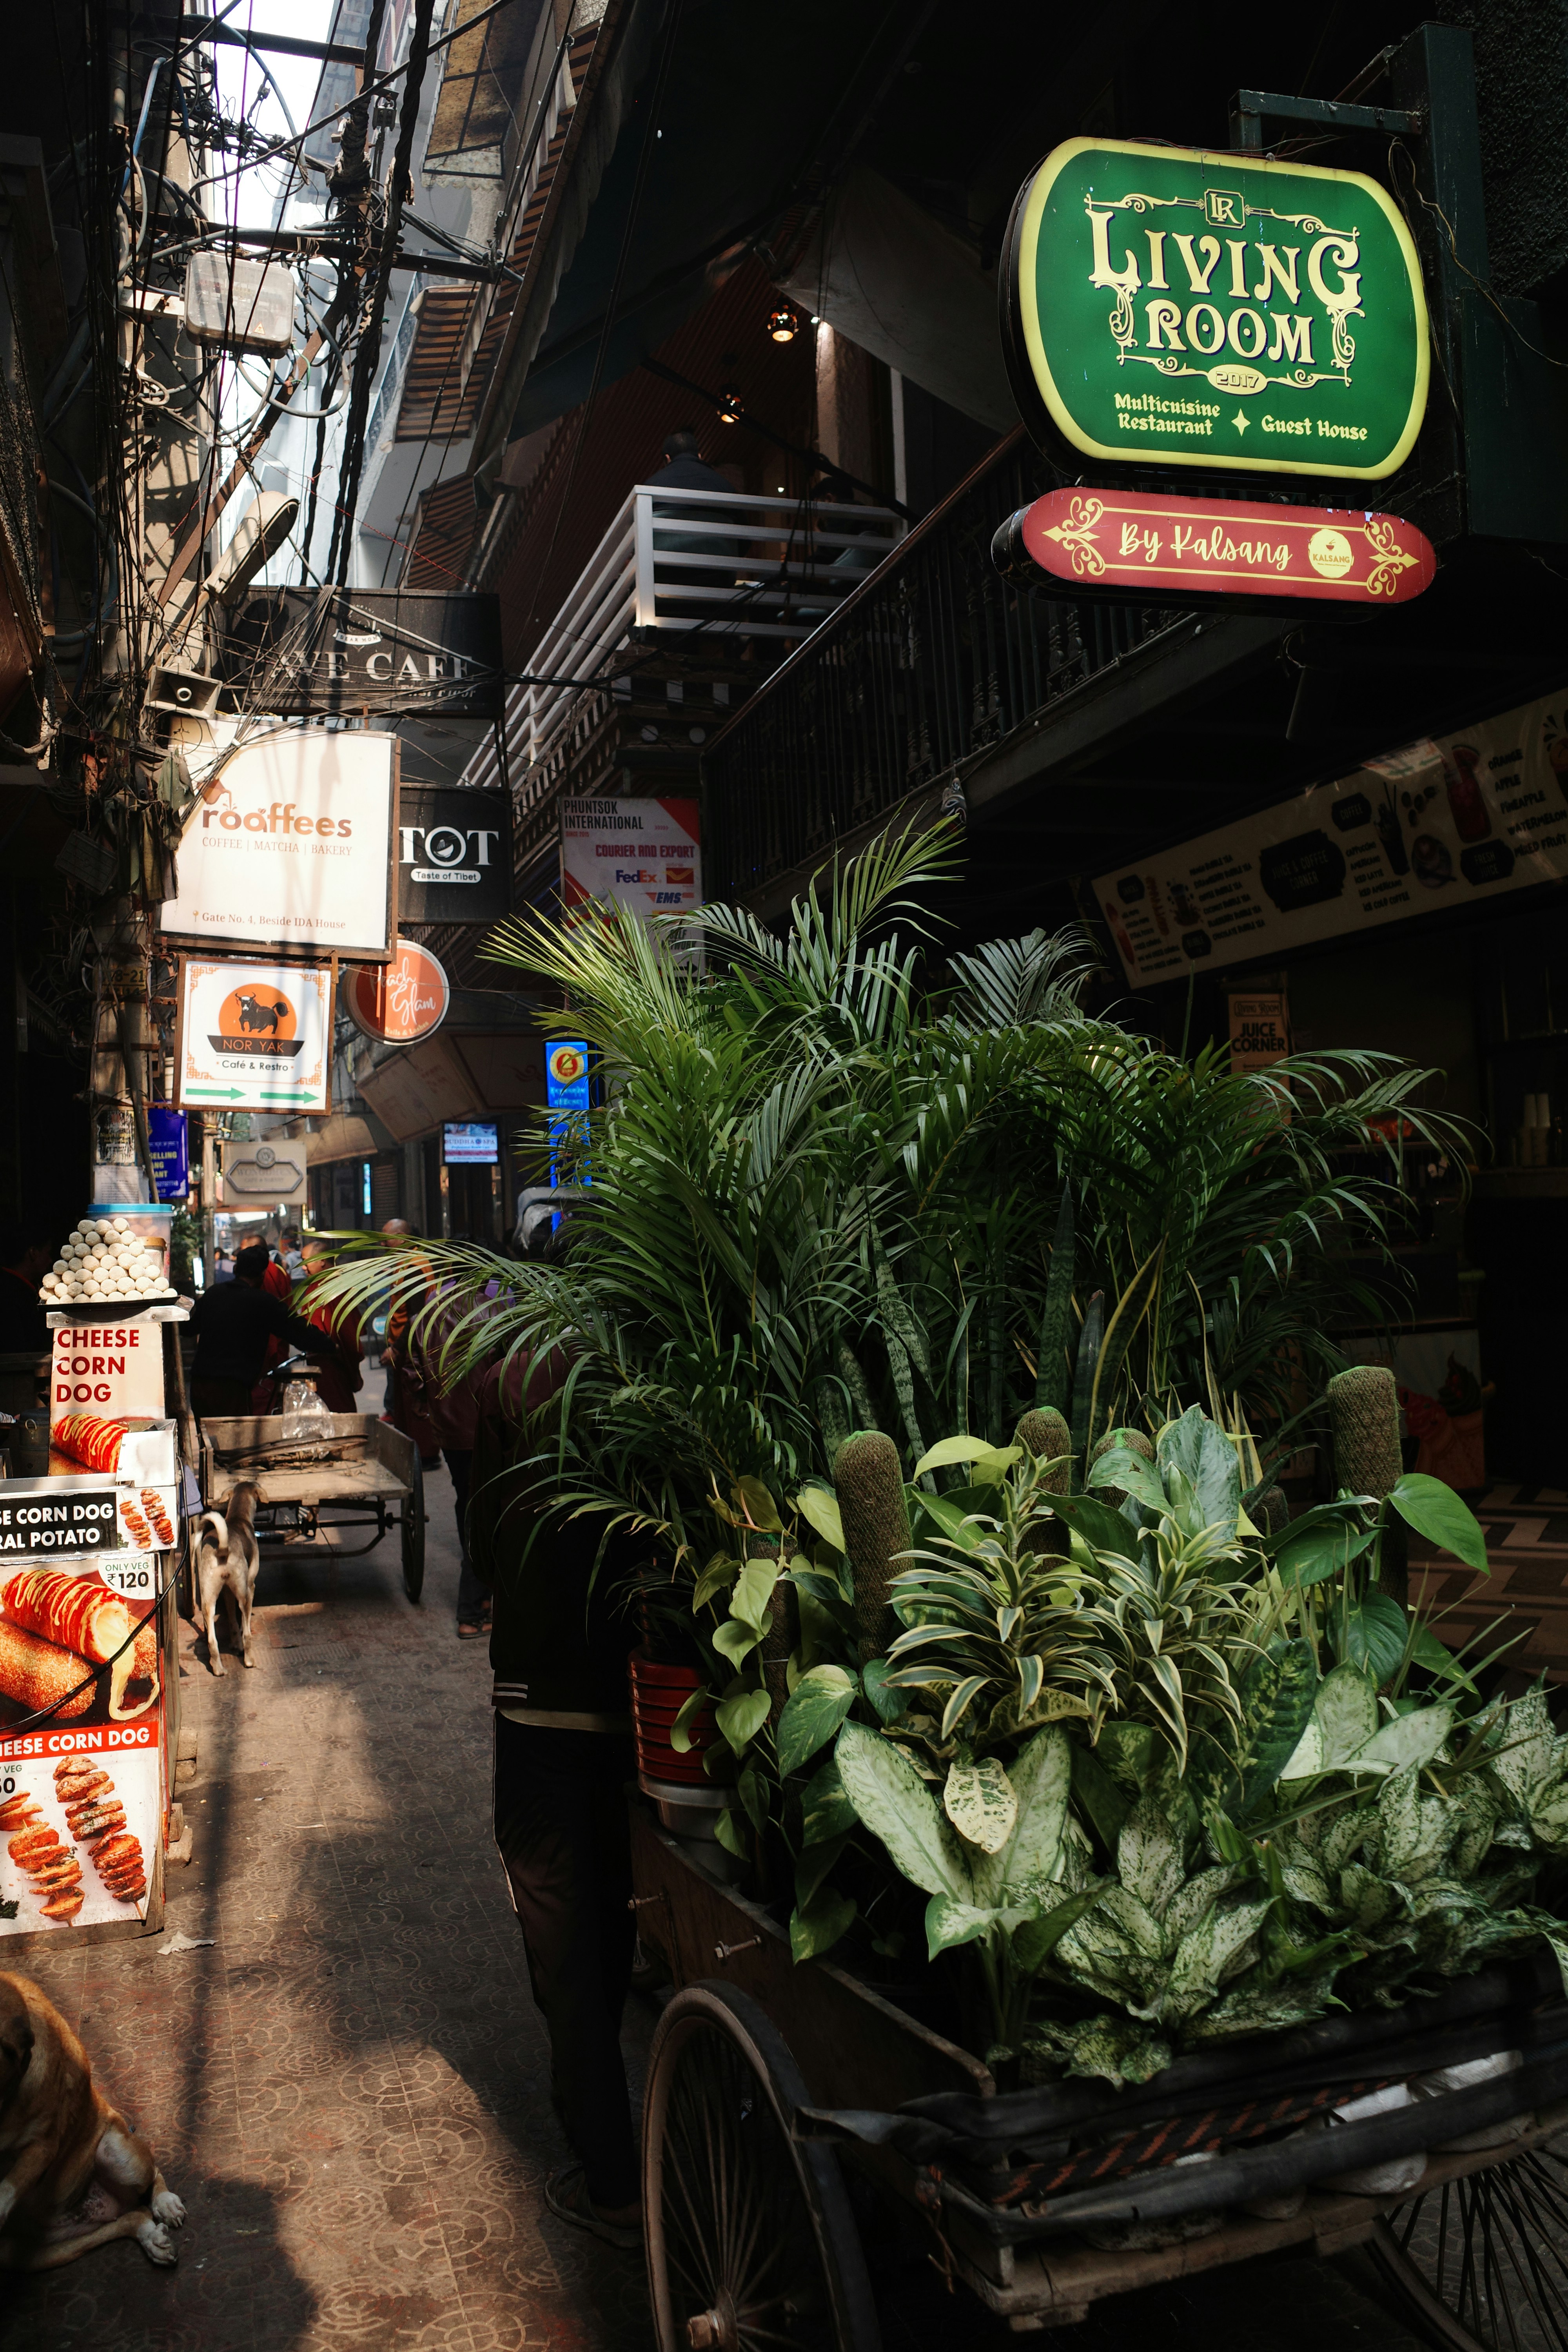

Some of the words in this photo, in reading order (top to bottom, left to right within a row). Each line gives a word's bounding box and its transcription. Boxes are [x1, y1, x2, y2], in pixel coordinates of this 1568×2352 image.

[1085, 208, 1363, 309] LIVING
[1145, 298, 1316, 364] ROOM
[1216, 371, 1259, 388] 2017
[1114, 393, 1220, 417] Multicuisine
[1118, 413, 1213, 436] Restaurant
[1261, 415, 1312, 436] Guest
[1317, 420, 1368, 441] House
[1119, 522, 1163, 563] By
[1170, 526, 1293, 571] Kalsang
[1313, 554, 1350, 563] KALSANG
[1494, 774, 1521, 792] APPLE
[564, 800, 618, 814] PHUNTSOK
[1500, 790, 1546, 814] PINEAPPLE
[1340, 804, 1364, 820] COFFEE
[565, 815, 644, 829] INTERNATIONAL
[202, 837, 242, 849] COFFEE
[254, 840, 299, 853] MATCHA
[311, 844, 352, 856] BAKERY
[398, 826, 499, 867] TOT
[1541, 833, 1567, 850] FRUIT
[596, 845, 636, 857] COURIER
[638, 845, 657, 857] AND
[660, 846, 695, 858] EXPORT
[1474, 851, 1496, 864] FRESH
[1272, 863, 1292, 880] JUICE
[1300, 850, 1329, 870] COFFEE
[1481, 863, 1499, 878] JUICE
[454, 873, 477, 881] Tibet
[616, 869, 657, 883] FedEx
[1289, 871, 1319, 890] CORNER
[656, 892, 682, 904] EMS
[202, 912, 225, 922] Gate
[229, 914, 245, 924] No.
[248, 915, 256, 925] 4,
[260, 916, 292, 926] Beside
[294, 917, 313, 927] IDA
[316, 919, 346, 929] House
[390, 983, 436, 1025] Glam
[1240, 1022, 1276, 1038] JUICE
[223, 1039, 252, 1051] NOR
[260, 1041, 284, 1053] YAK
[1232, 1038, 1286, 1052] CORNER
[222, 1060, 246, 1069] Café
[260, 1062, 289, 1071] Restro
[57, 1329, 140, 1348] CHEESE
[56, 1356, 125, 1376] CORN
[56, 1383, 112, 1402] DOG
[16, 1506, 67, 1524] CORN
[73, 1503, 114, 1521] DOG
[30, 1527, 100, 1547] POTATO
[105, 1563, 130, 1572] ONLY
[131, 1562, 149, 1570] VEG
[107, 1572, 149, 1589] ₹120
[48, 1732, 102, 1751] CORN
[109, 1727, 150, 1746] DOG
[4, 1764, 22, 1773] VEG
